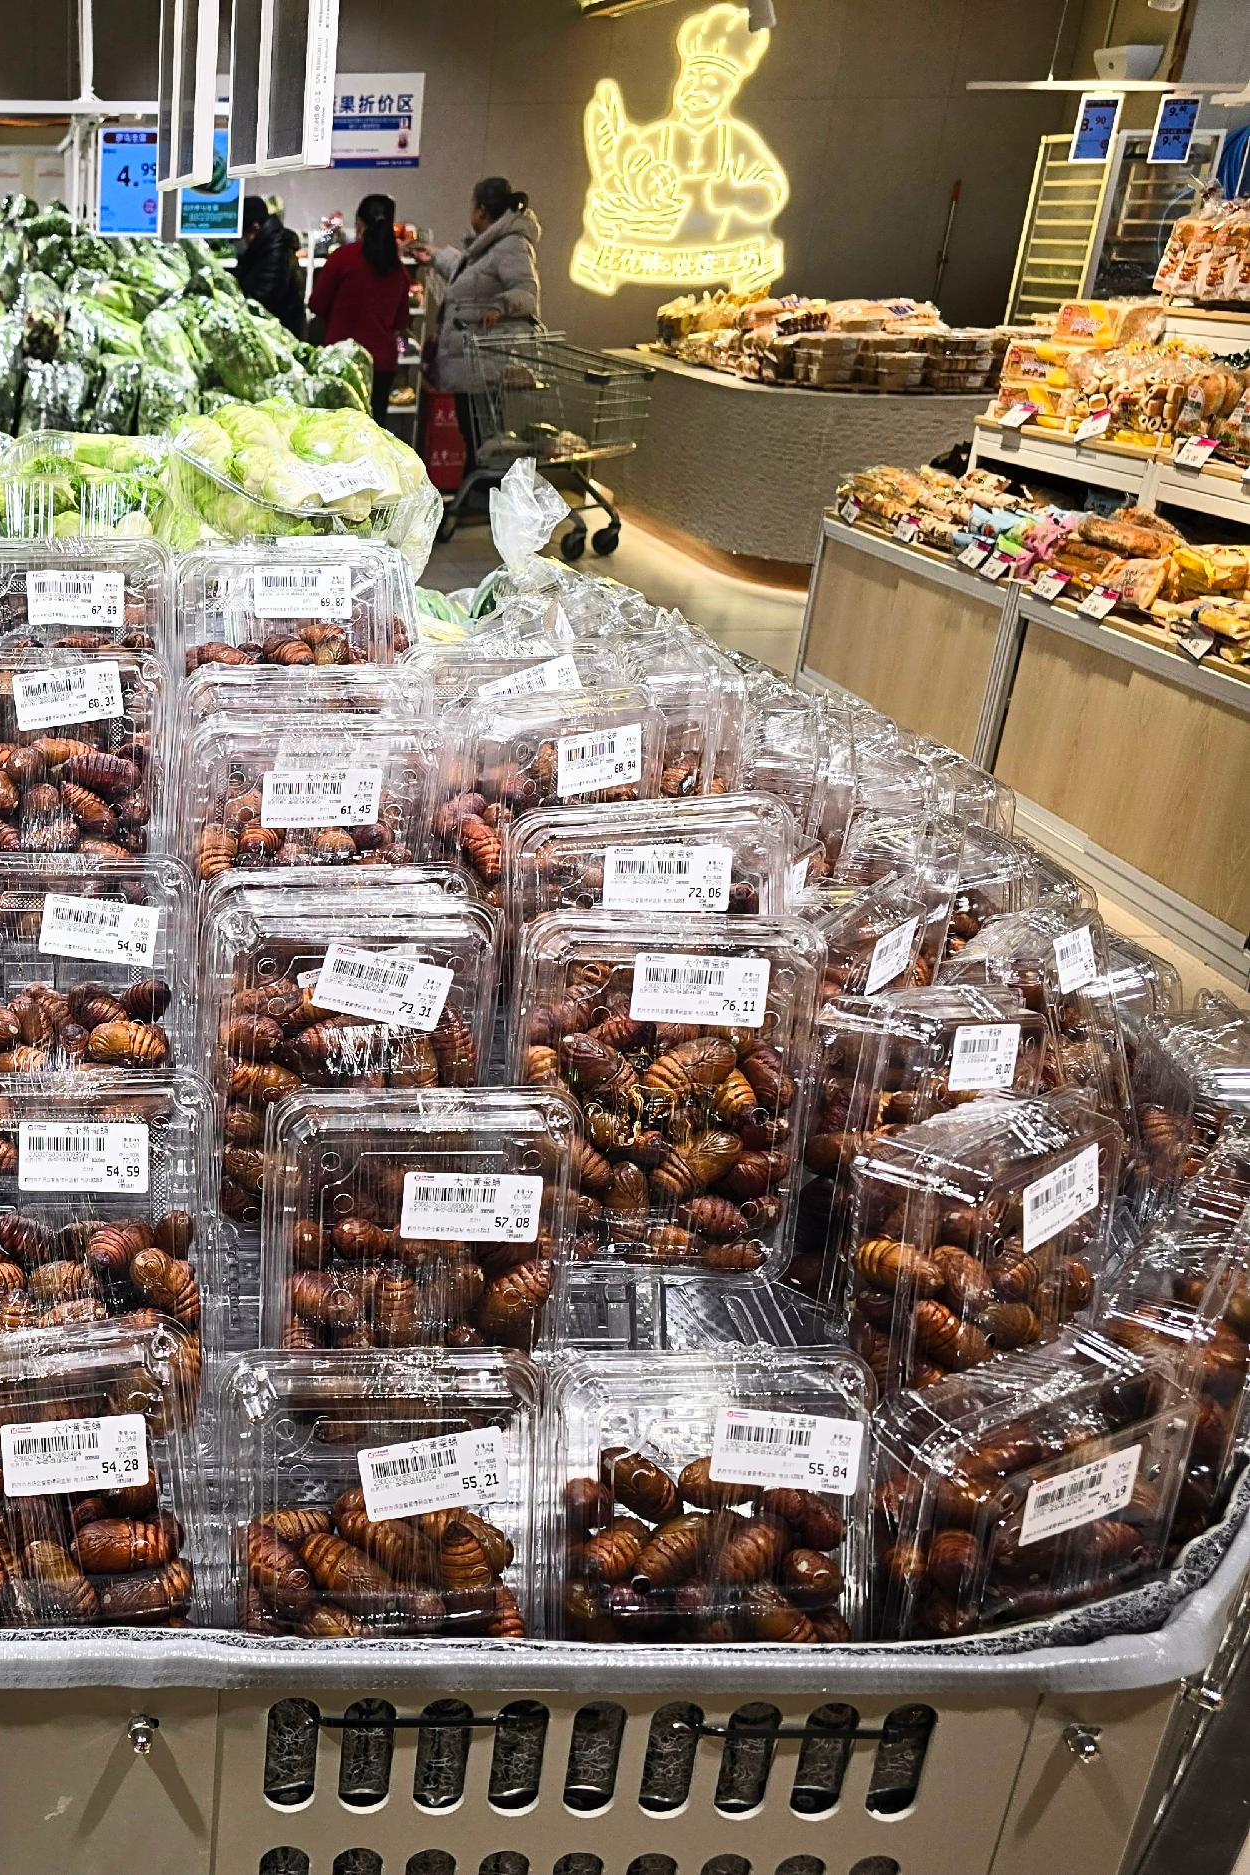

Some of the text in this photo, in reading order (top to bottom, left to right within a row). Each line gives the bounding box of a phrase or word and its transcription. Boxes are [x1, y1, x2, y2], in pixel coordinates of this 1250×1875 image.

[333, 93, 413, 114] 果折价区
[1081, 115, 1107, 132] 8.90
[116, 163, 157, 188] 4.99
[341, 805, 371, 814] 61.45
[117, 941, 147, 953] 54.90
[398, 1002, 432, 1018] 73.31
[722, 1000, 756, 1012] 76.11
[106, 1165, 140, 1177] 54.59
[494, 1216, 530, 1228] 57.08
[101, 1459, 139, 1473] 54.28
[808, 1462, 848, 1479] 55.84
[462, 1473, 500, 1490] 55.21
